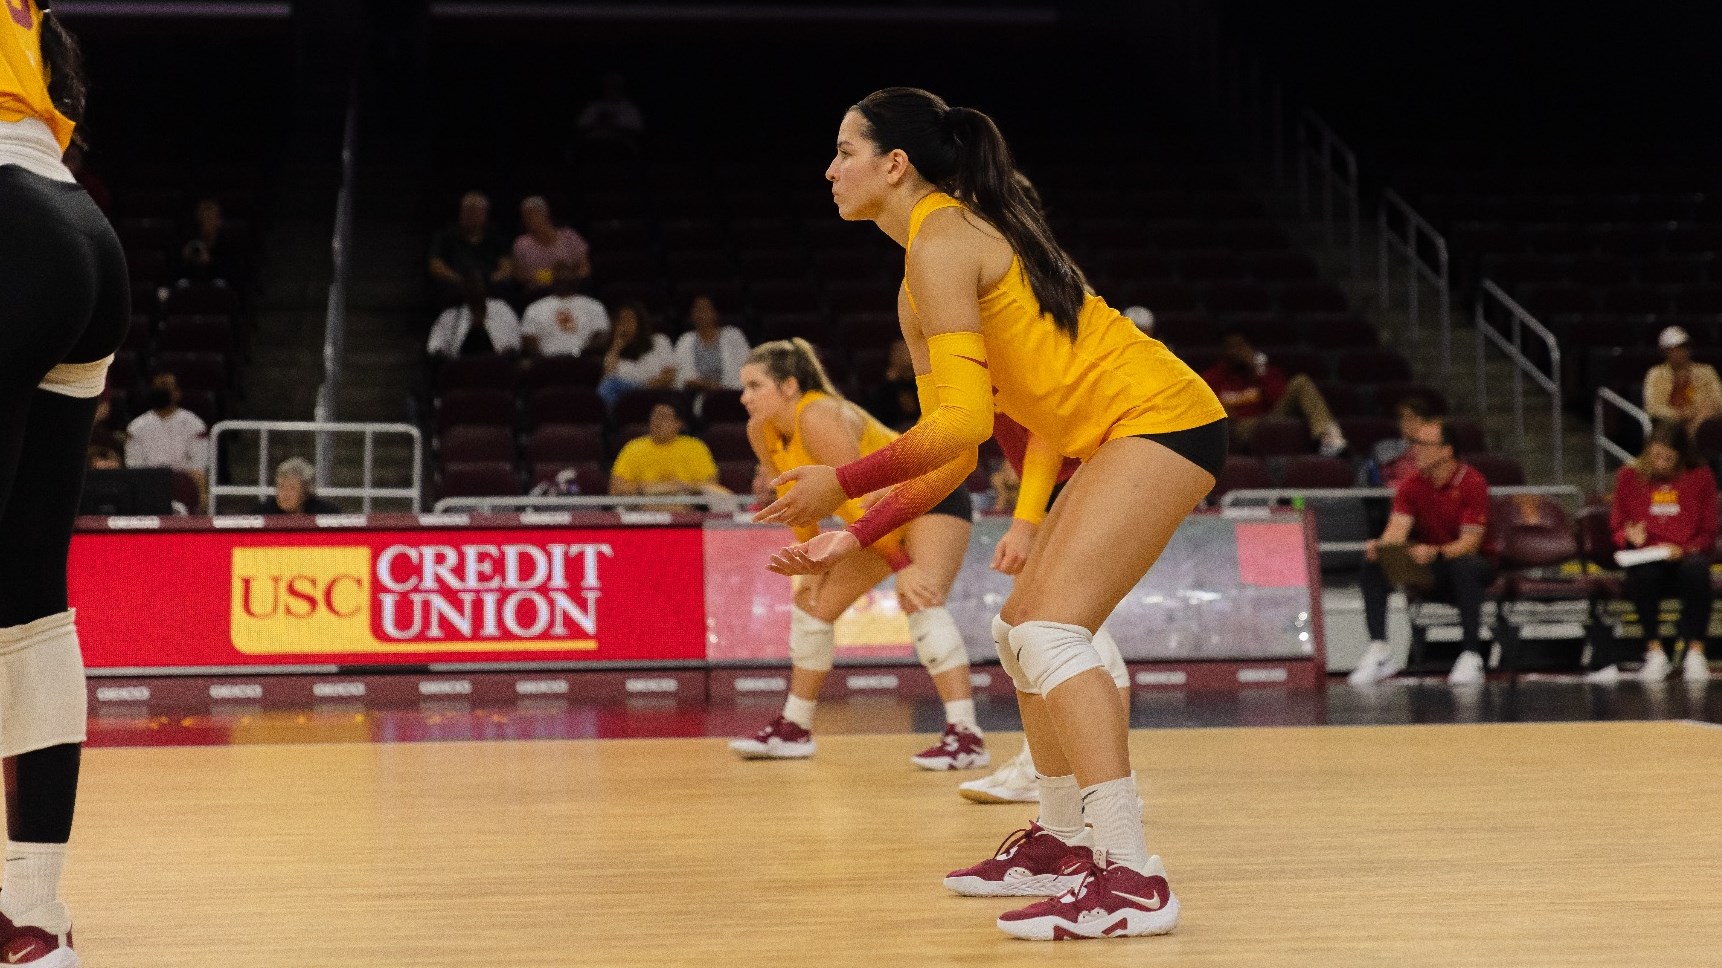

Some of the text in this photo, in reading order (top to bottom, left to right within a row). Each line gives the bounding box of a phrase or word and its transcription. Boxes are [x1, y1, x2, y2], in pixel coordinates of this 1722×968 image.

[376, 543, 614, 592] CREDIT
[239, 574, 363, 619] USC
[378, 589, 602, 639] UNION
